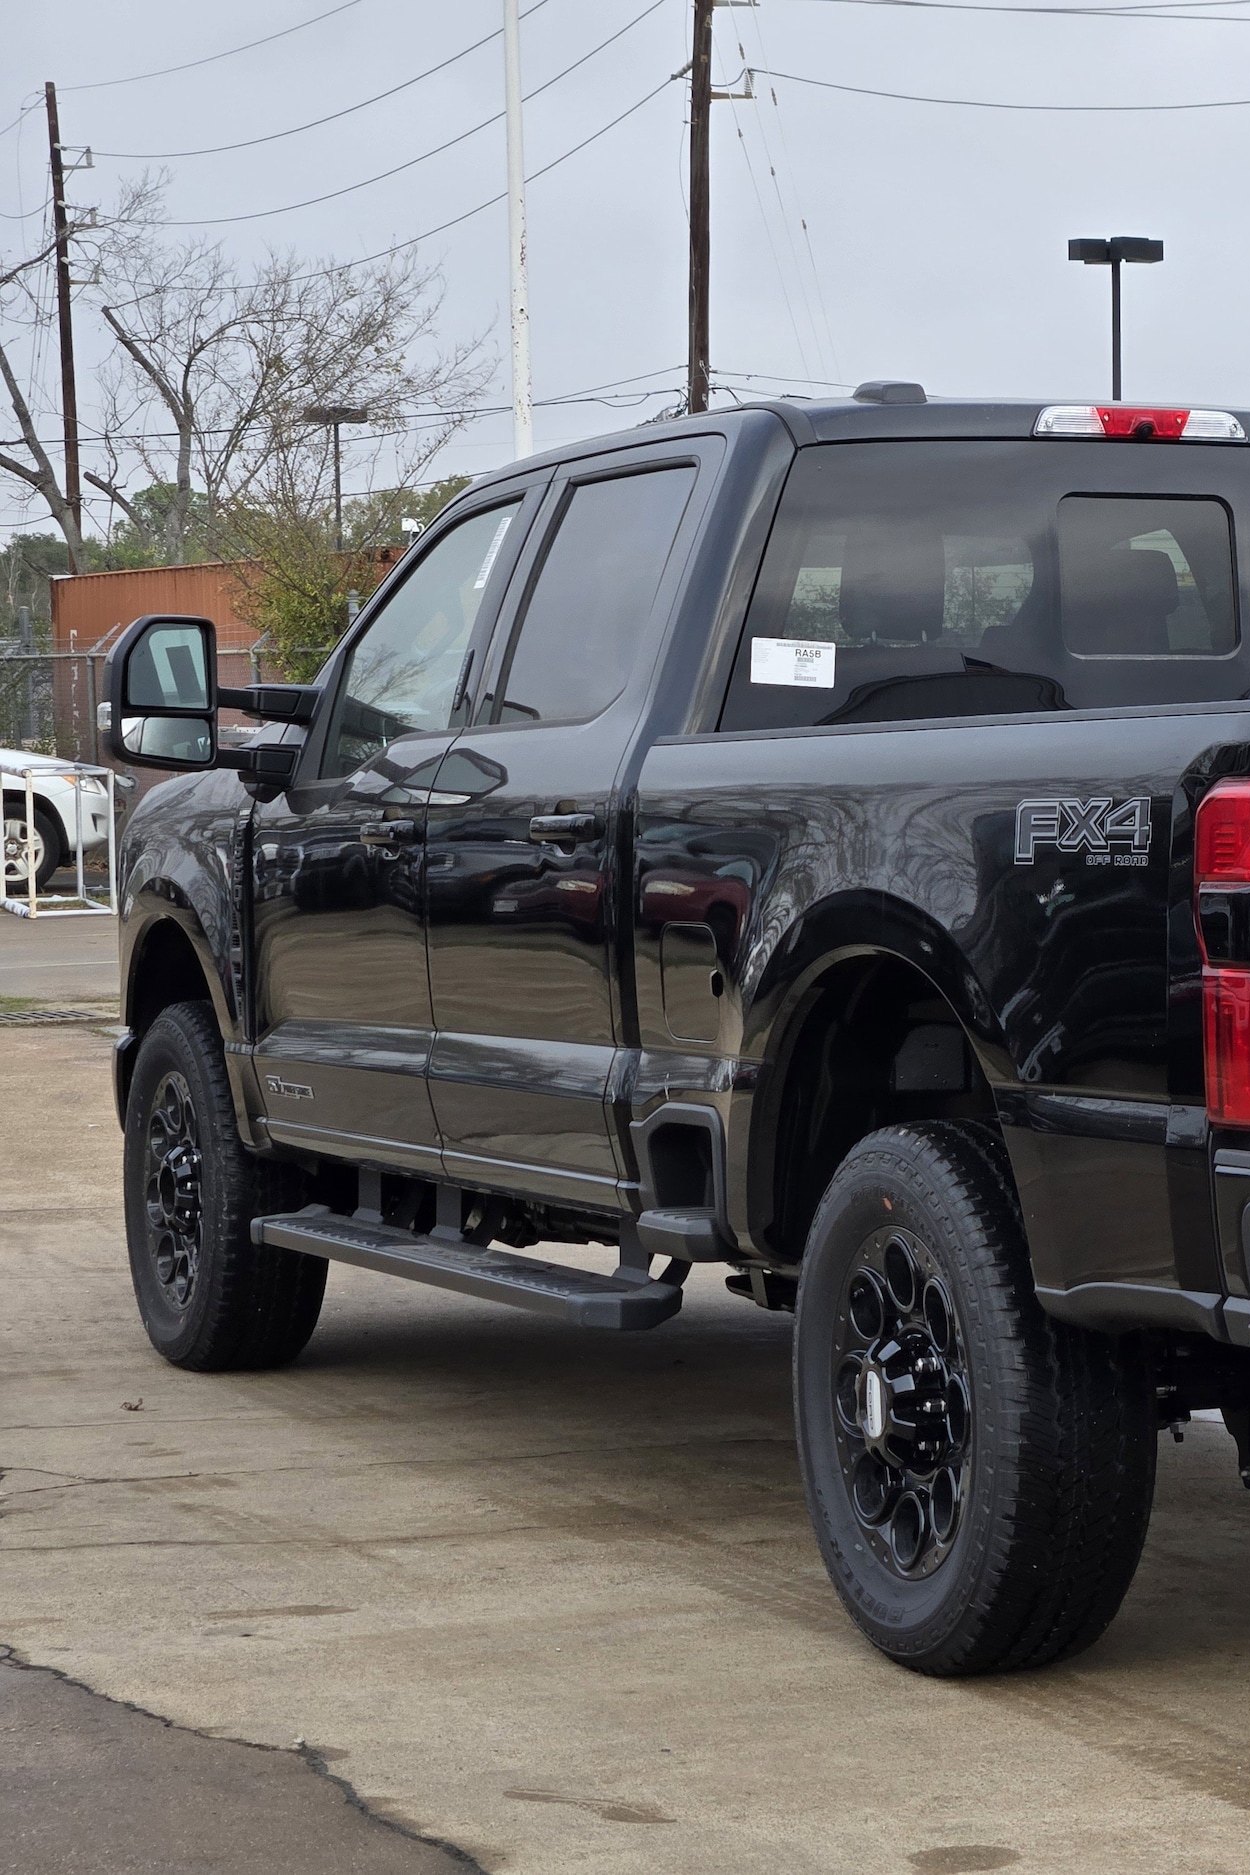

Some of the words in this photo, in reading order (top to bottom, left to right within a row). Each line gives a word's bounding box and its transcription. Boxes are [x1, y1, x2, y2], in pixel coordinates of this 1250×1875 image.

[795, 648, 822, 658] RA5B
[1014, 797, 1152, 865] FX4
[1086, 854, 1111, 865] OFF
[1114, 855, 1149, 866] ROAD
